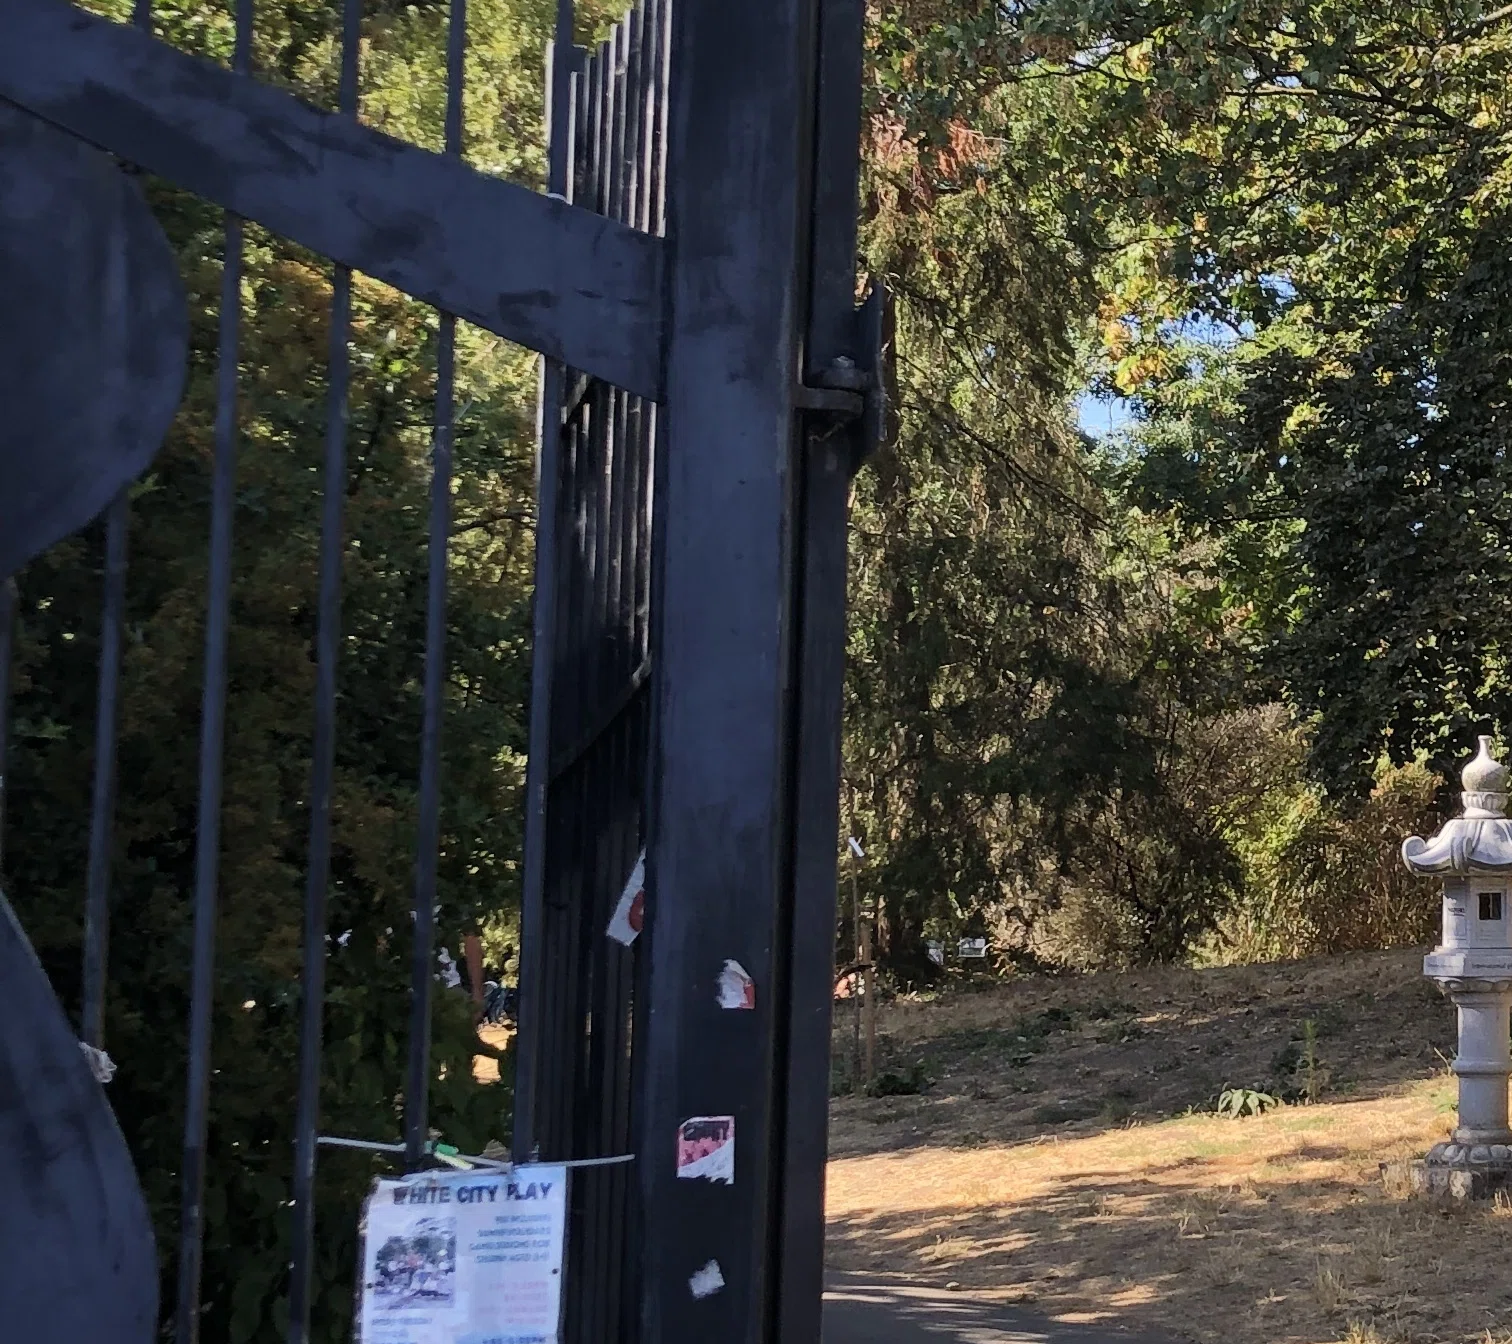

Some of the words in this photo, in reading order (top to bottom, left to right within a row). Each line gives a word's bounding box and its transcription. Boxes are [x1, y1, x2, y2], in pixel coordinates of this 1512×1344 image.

[394, 1186, 450, 1205] WHITE
[457, 1184, 499, 1203] CITY
[507, 1182, 553, 1201] PLAY
